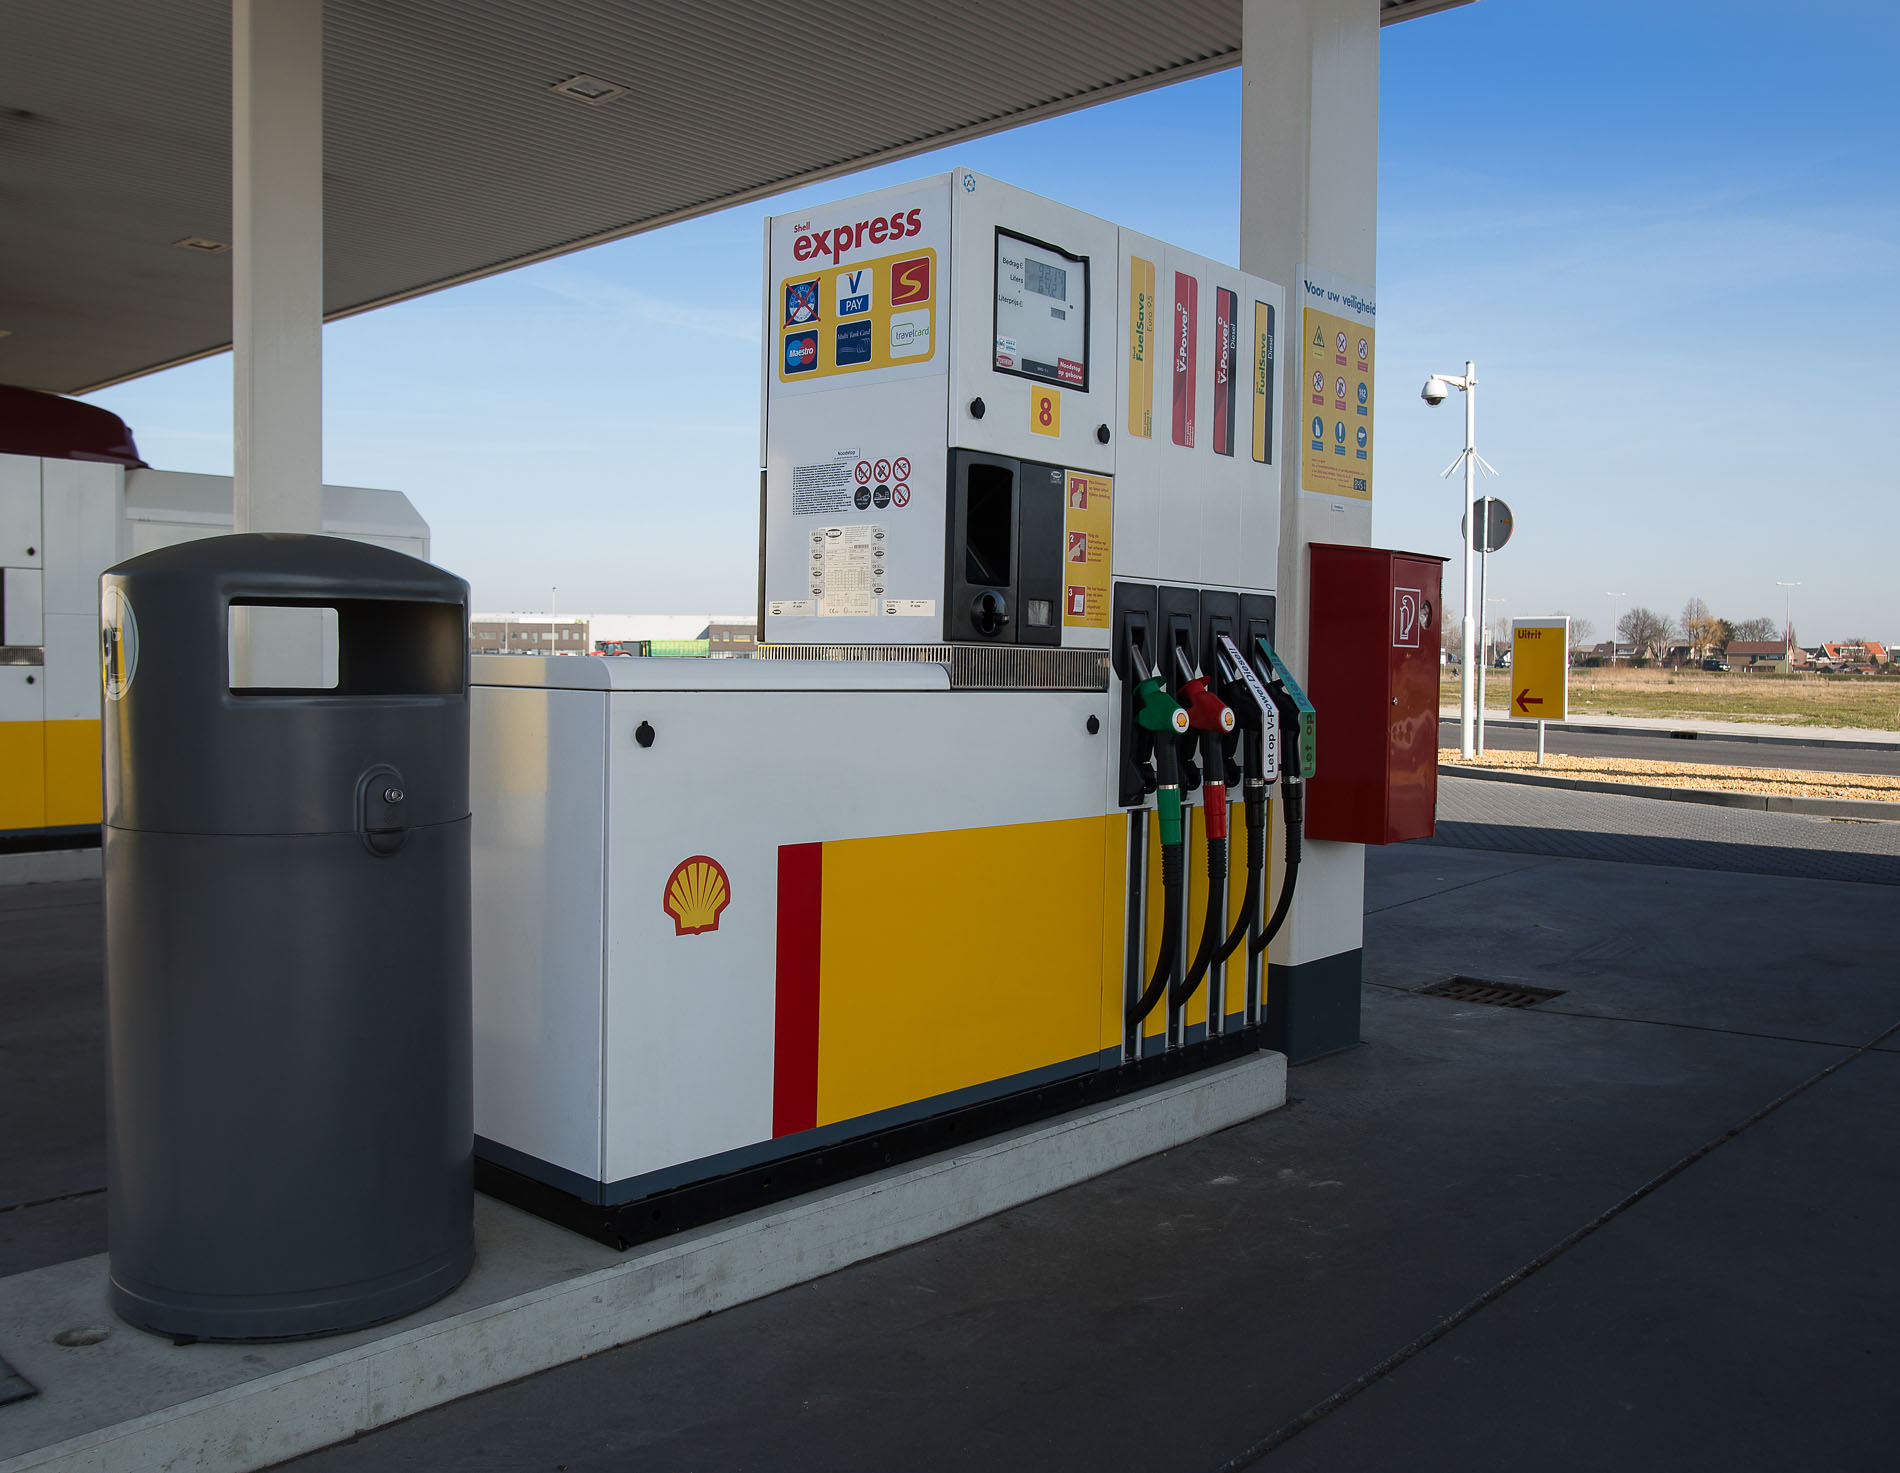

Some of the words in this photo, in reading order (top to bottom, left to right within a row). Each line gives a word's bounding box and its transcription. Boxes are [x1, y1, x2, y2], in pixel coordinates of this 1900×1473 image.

[794, 221, 811, 233] Shell
[793, 208, 922, 265] express
[1002, 257, 1019, 269] Bedrag
[1010, 274, 1024, 284] Liters
[845, 298, 863, 312] PAY
[1304, 280, 1325, 298] Voor
[1327, 291, 1340, 303] uw
[1342, 294, 1376, 316] veiligheid
[896, 325, 930, 340] travelcard
[1135, 292, 1145, 362] FuelSave
[1179, 307, 1188, 373] V-Power
[788, 346, 814, 358] Maestro
[1220, 320, 1229, 384] V-Power
[1060, 361, 1081, 372] Noodstop
[1257, 333, 1267, 395] FuelSave
[1039, 397, 1052, 426] 8
[1071, 480, 1075, 489] 1
[1069, 534, 1075, 543] 2
[1068, 588, 1073, 597] 3
[1518, 629, 1542, 640] Uitrit
[1253, 684, 1275, 730] V-Power
[1306, 714, 1314, 736] op
[1268, 734, 1276, 750] op
[1267, 752, 1275, 774] Let
[1304, 744, 1313, 772] Let
